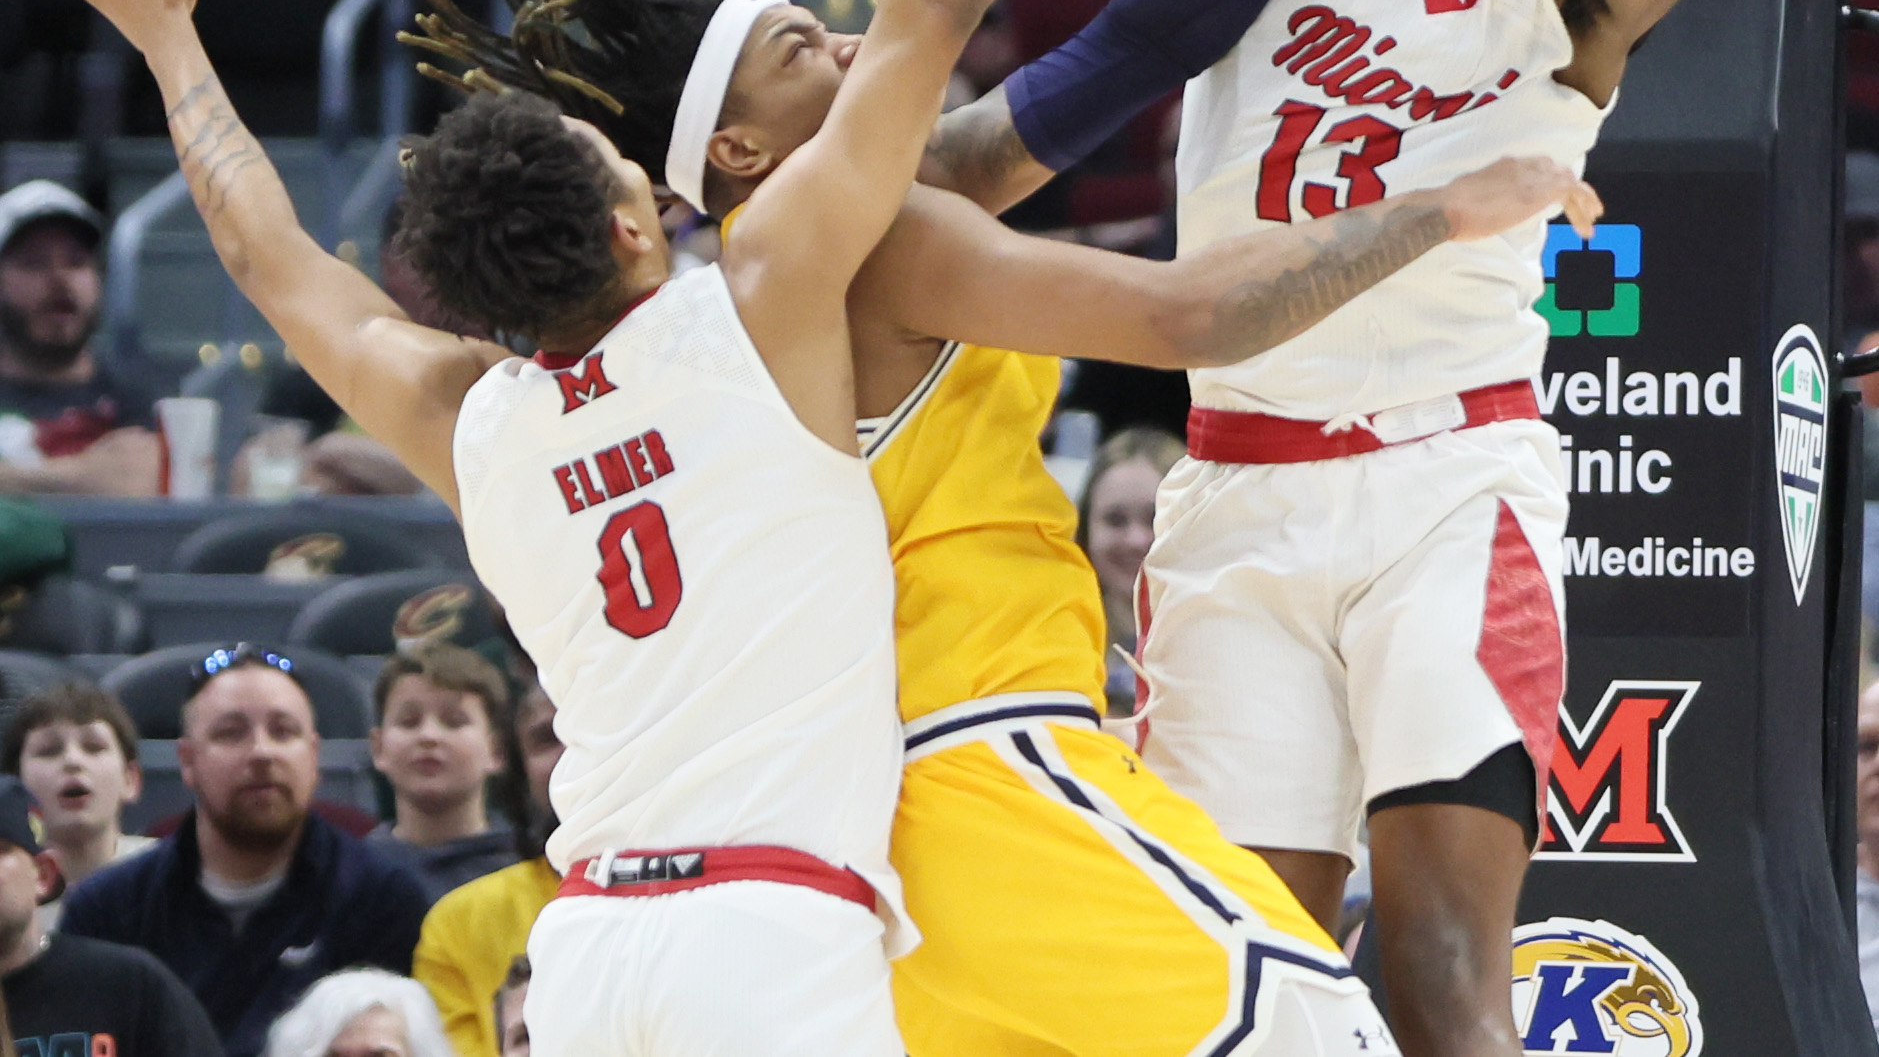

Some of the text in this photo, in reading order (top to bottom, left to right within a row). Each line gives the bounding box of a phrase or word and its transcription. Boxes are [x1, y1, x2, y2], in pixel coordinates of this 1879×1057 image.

[1271, 4, 1520, 122] Miami
[1256, 98, 1404, 224] 13
[553, 350, 619, 416] M
[1531, 357, 1742, 416] veland
[551, 428, 675, 515] ELMER
[1560, 435, 1673, 493] inic
[1781, 412, 1822, 480] MAC
[596, 498, 683, 640] 0
[1562, 537, 1755, 577] Medicine
[1530, 680, 1702, 863] M
[1522, 960, 1638, 1054] K
